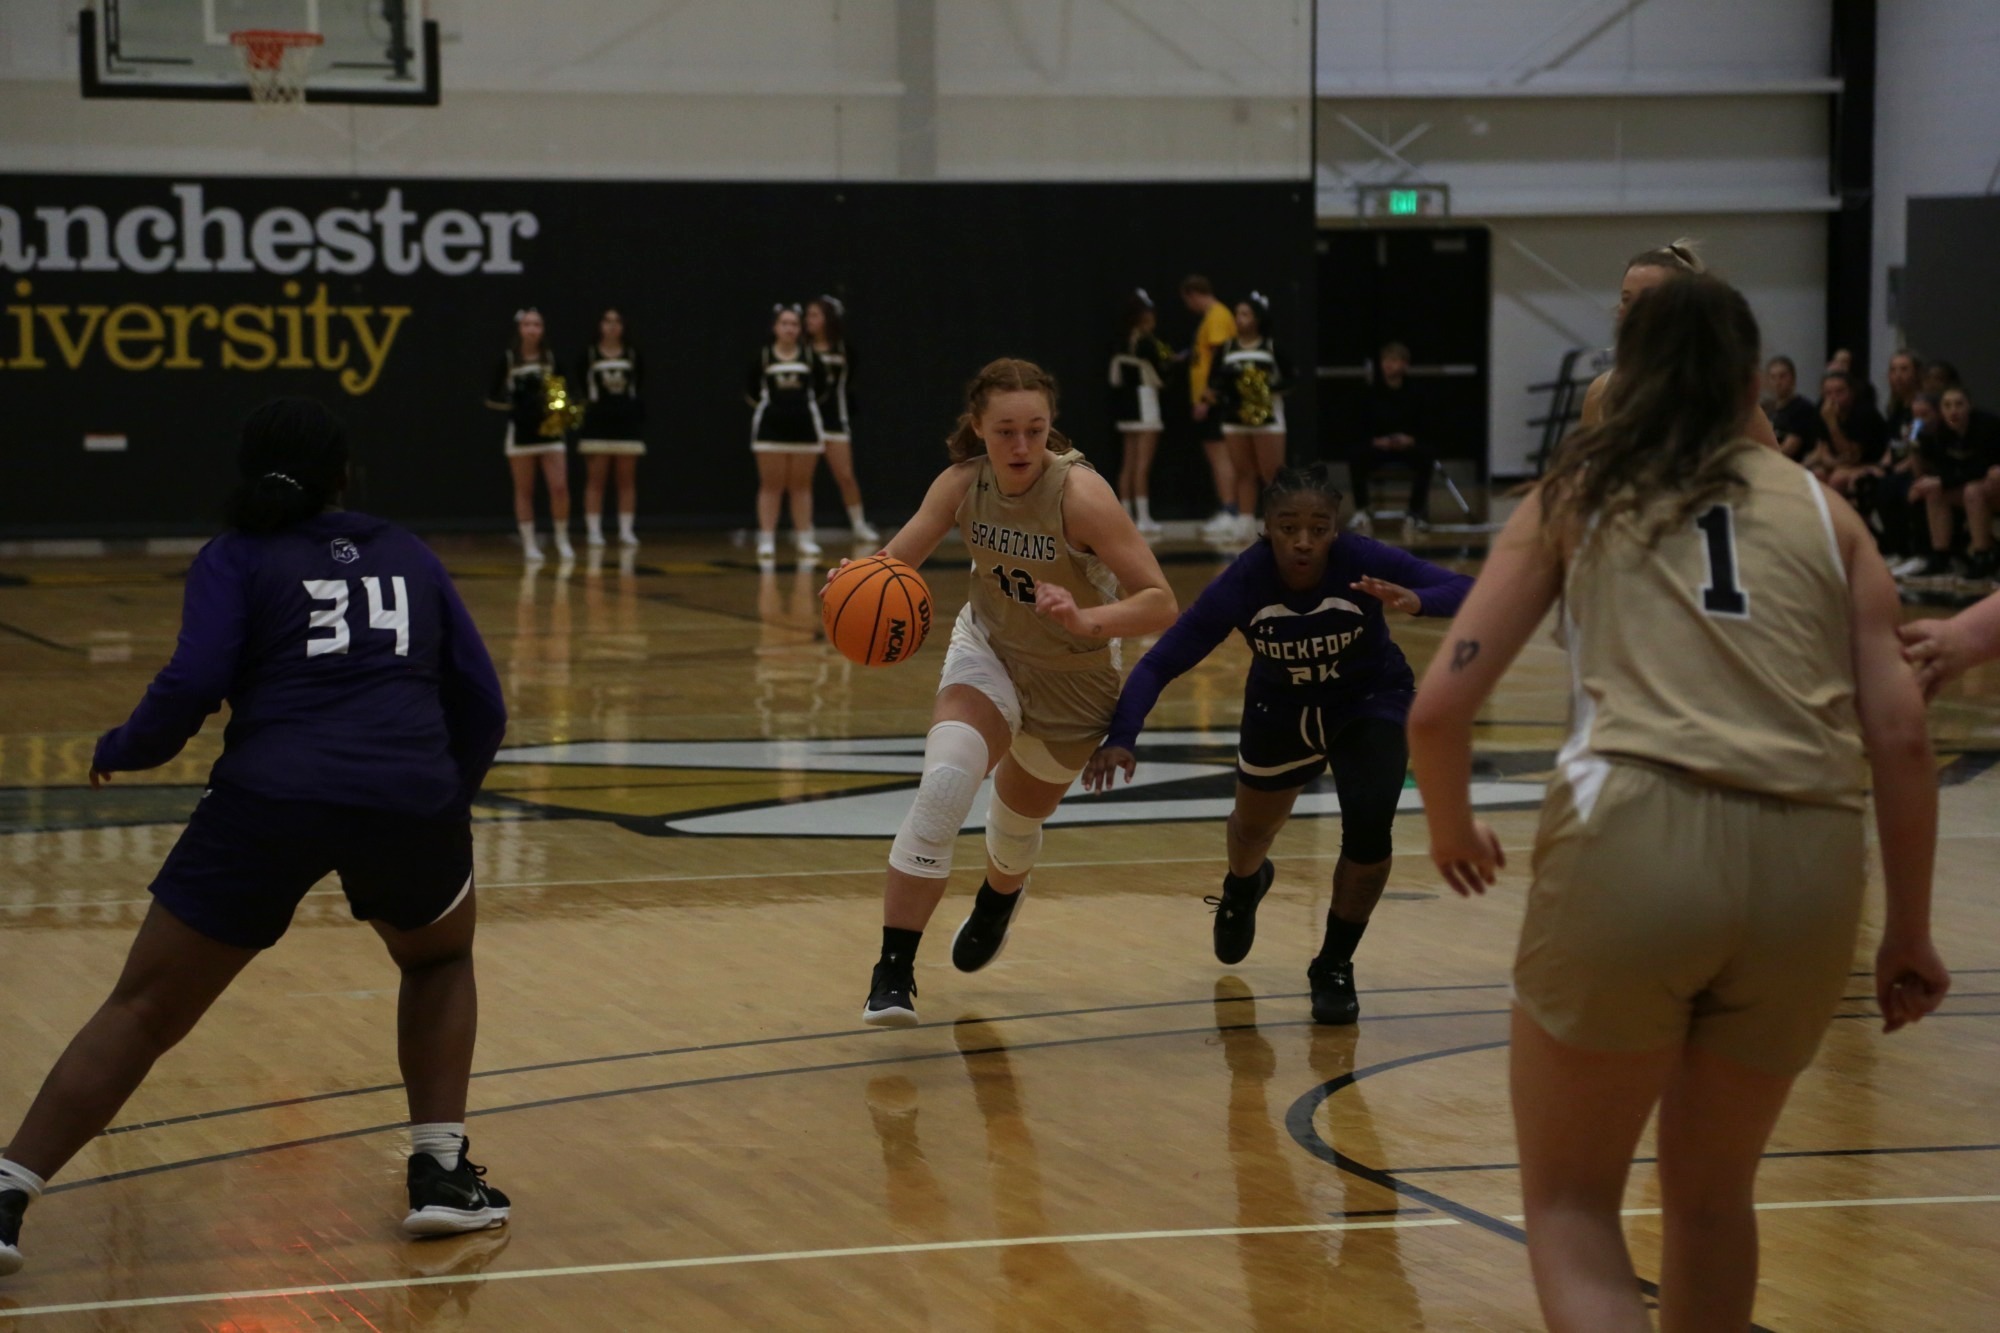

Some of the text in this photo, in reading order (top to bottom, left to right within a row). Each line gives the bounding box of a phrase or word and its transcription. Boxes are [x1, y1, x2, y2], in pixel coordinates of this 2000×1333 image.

[0, 280, 411, 395] iversity
[971, 520, 1057, 561] SPARTANS
[1695, 504, 1748, 617] 1
[301, 575, 410, 659] 34
[992, 564, 1037, 604] 12
